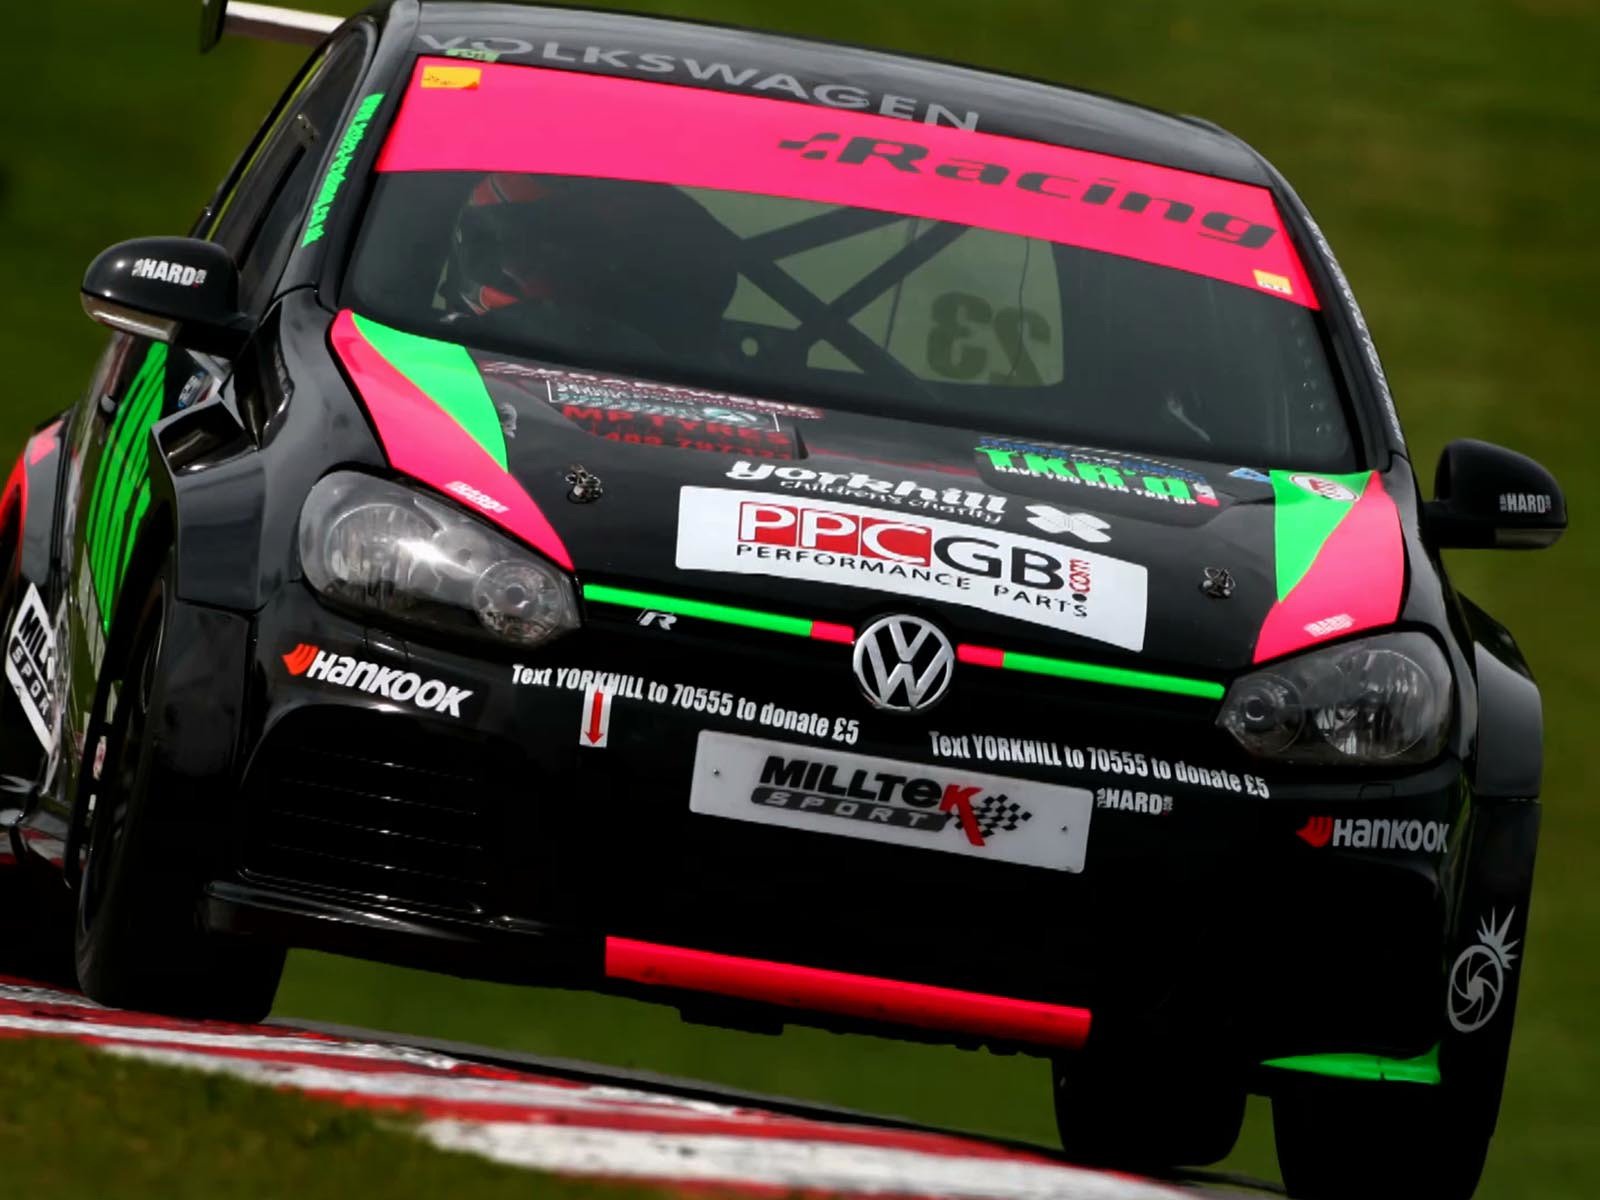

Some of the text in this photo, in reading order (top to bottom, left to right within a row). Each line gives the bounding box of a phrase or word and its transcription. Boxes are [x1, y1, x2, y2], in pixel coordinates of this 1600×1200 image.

[418, 34, 979, 132] VOLKSWAGEN
[834, 136, 1278, 250] Racing
[725, 461, 1007, 514] yorkhill
[737, 544, 1089, 619] PERFORMANCE PARTS
[512, 664, 860, 745] Text YORKHILL to 70555 to donate £5
[929, 730, 1271, 799] Text YORKHILL to 70555 to donate £5
[764, 790, 931, 828] SPORT
[1106, 787, 1163, 815] HARD
